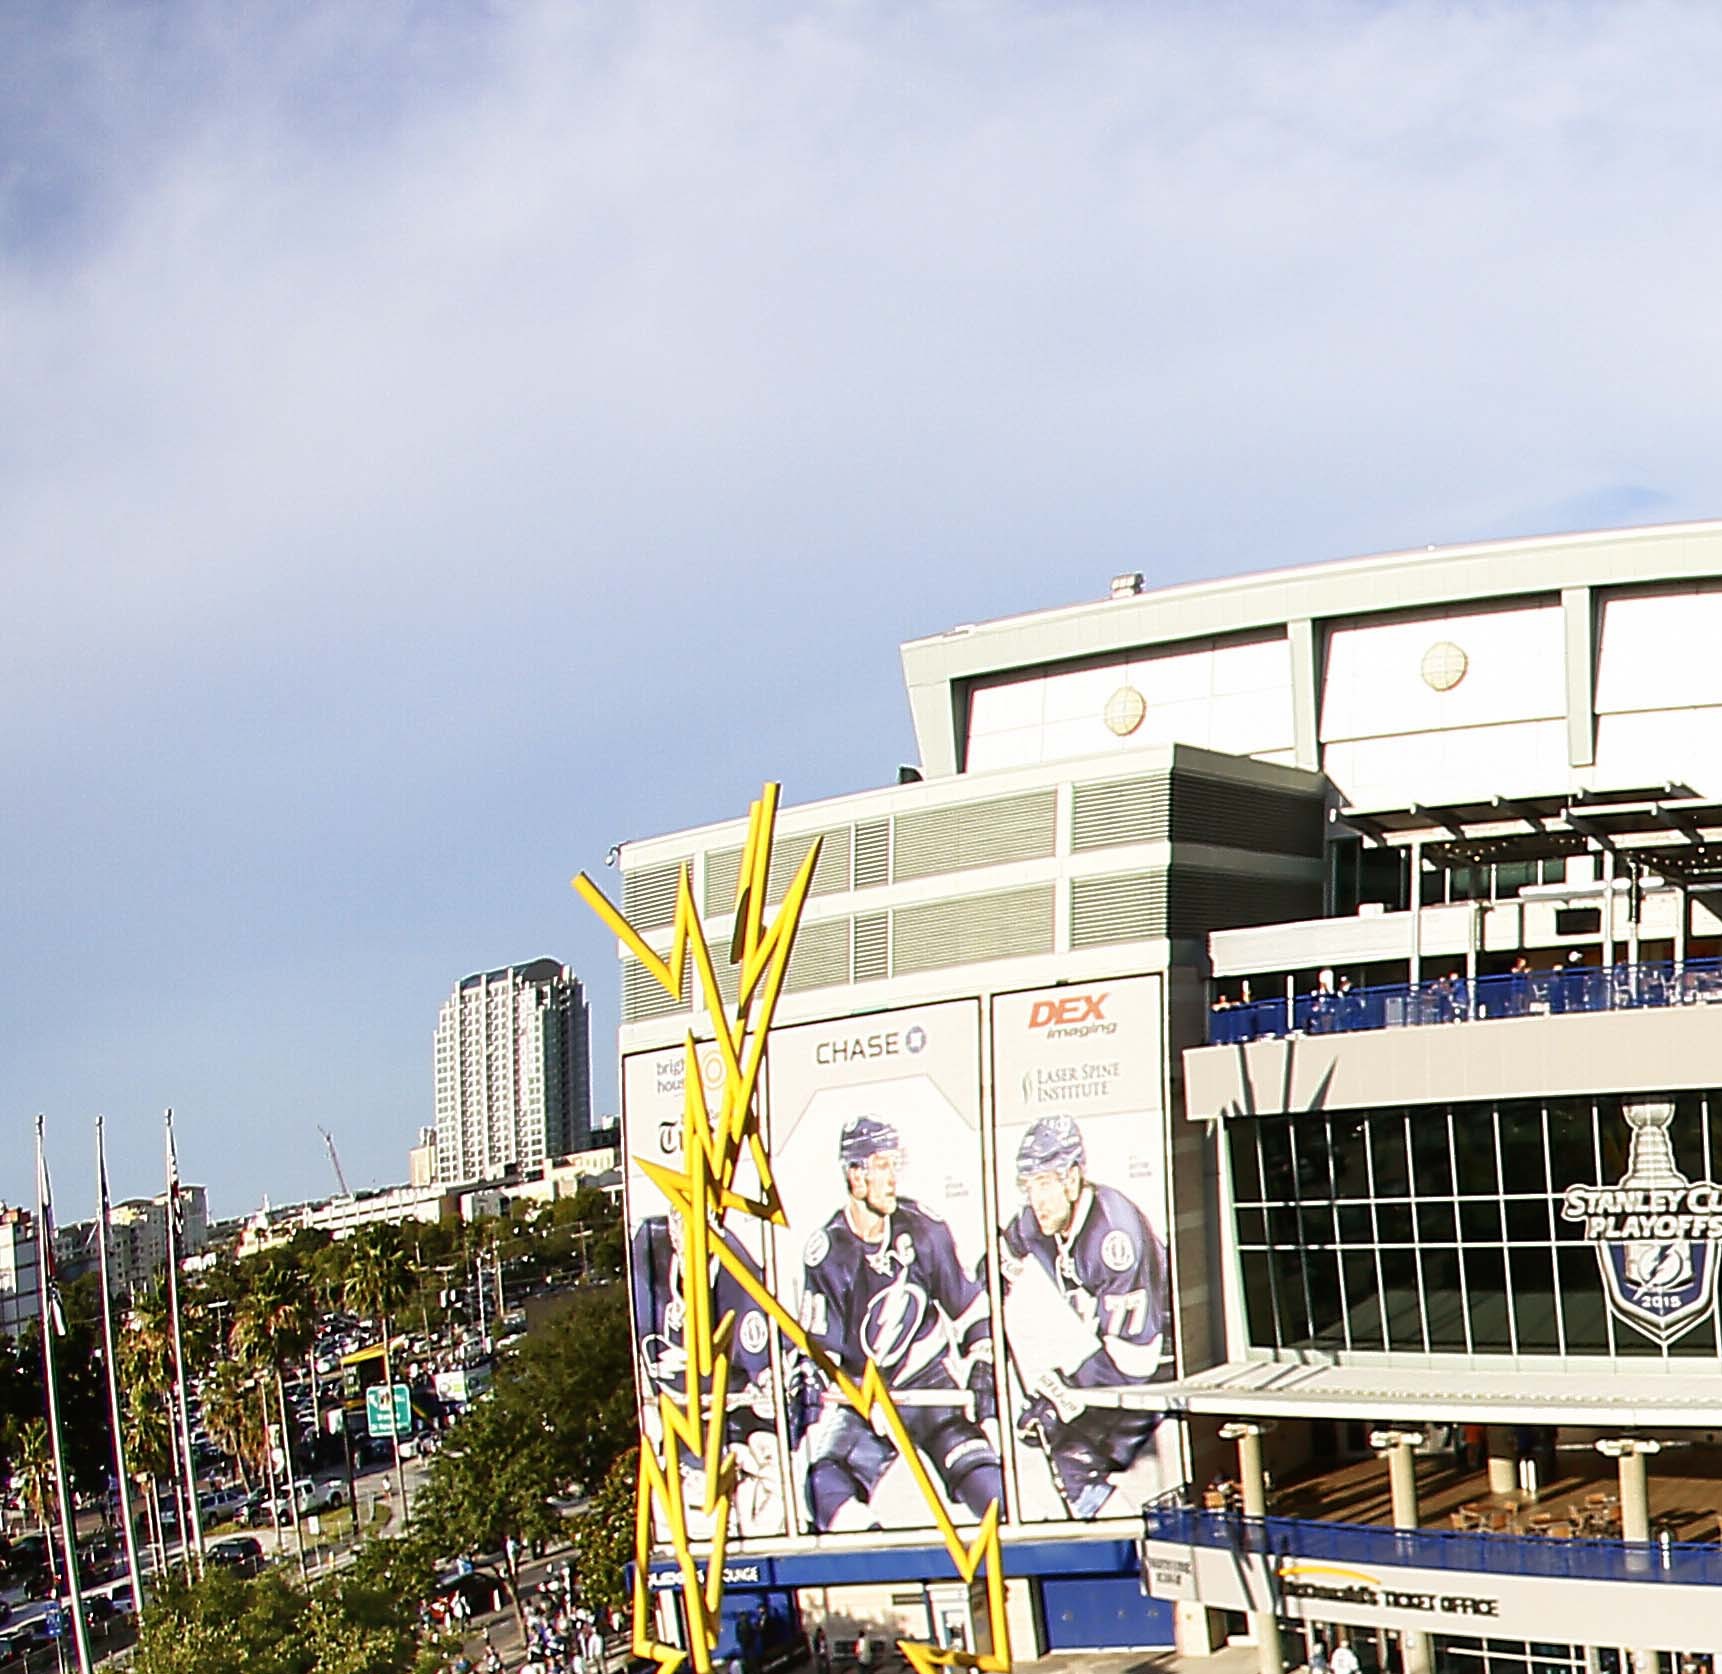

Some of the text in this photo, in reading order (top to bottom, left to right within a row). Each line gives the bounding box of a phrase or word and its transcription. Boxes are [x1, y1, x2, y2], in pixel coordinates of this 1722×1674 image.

[1028, 992, 1110, 1029] DEX
[1046, 1021, 1118, 1039] imaging
[815, 1032, 900, 1066] CHASE
[1036, 1063, 1120, 1085] LASER SPINE
[1036, 1081, 1110, 1103] INSTITUTE
[1566, 1188, 1687, 1216] STANLEY
